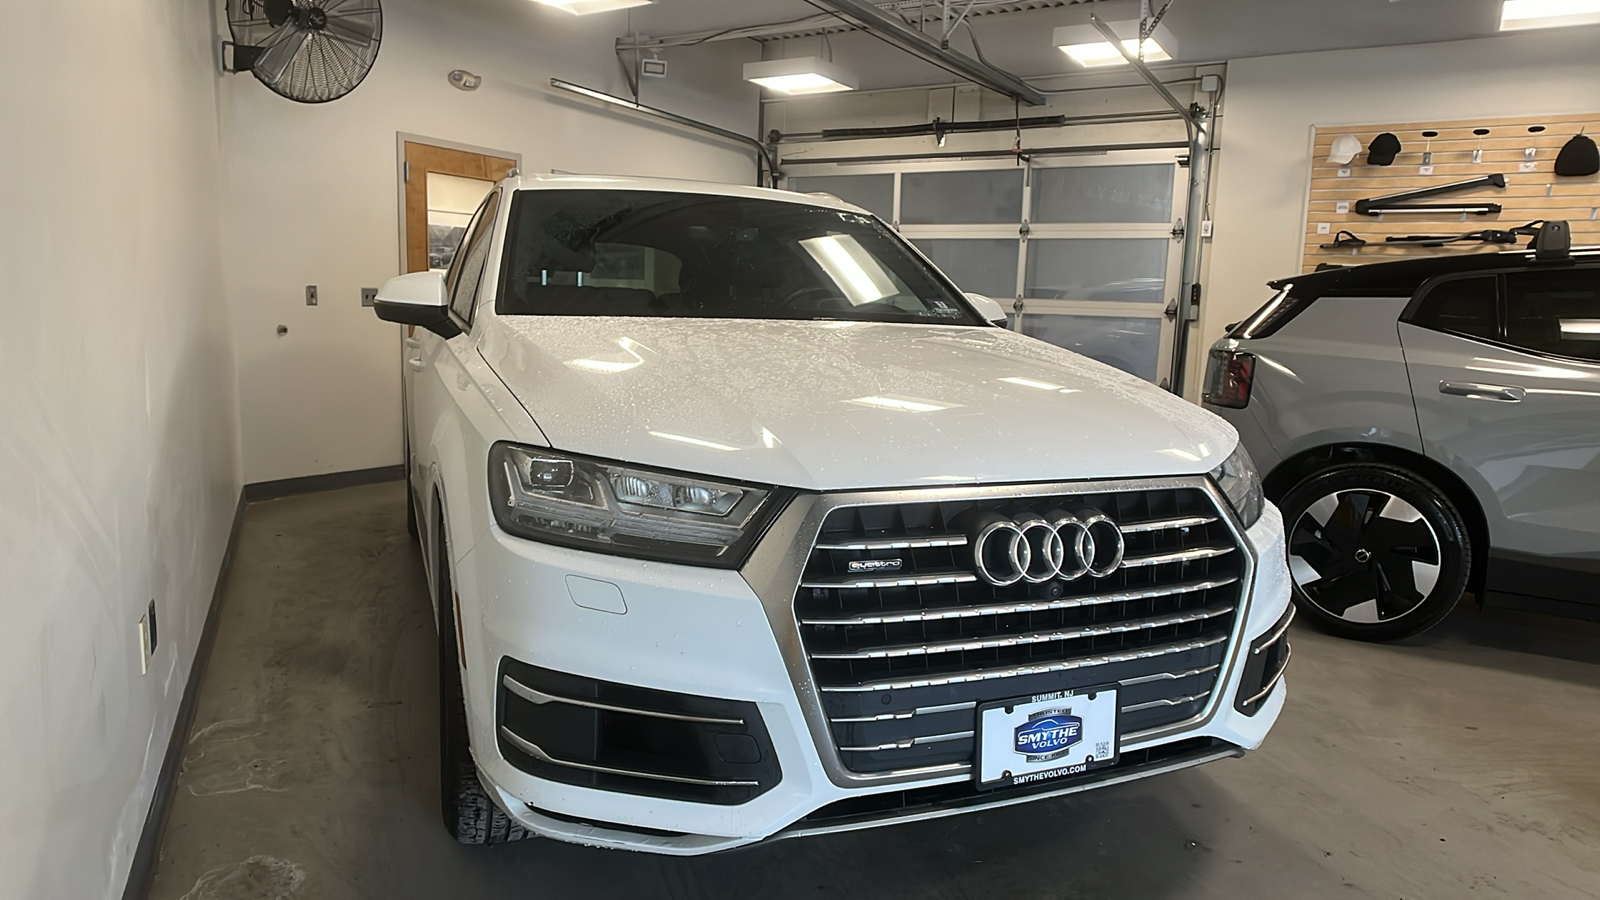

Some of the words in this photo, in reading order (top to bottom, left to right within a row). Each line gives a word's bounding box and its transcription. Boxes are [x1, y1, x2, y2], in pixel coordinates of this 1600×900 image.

[1064, 689, 1074, 698] NJ
[1018, 727, 1078, 745] SMYTHE
[1032, 738, 1068, 749] VOLVO
[1013, 764, 1087, 785] SMYTHEVOLVO.COM
